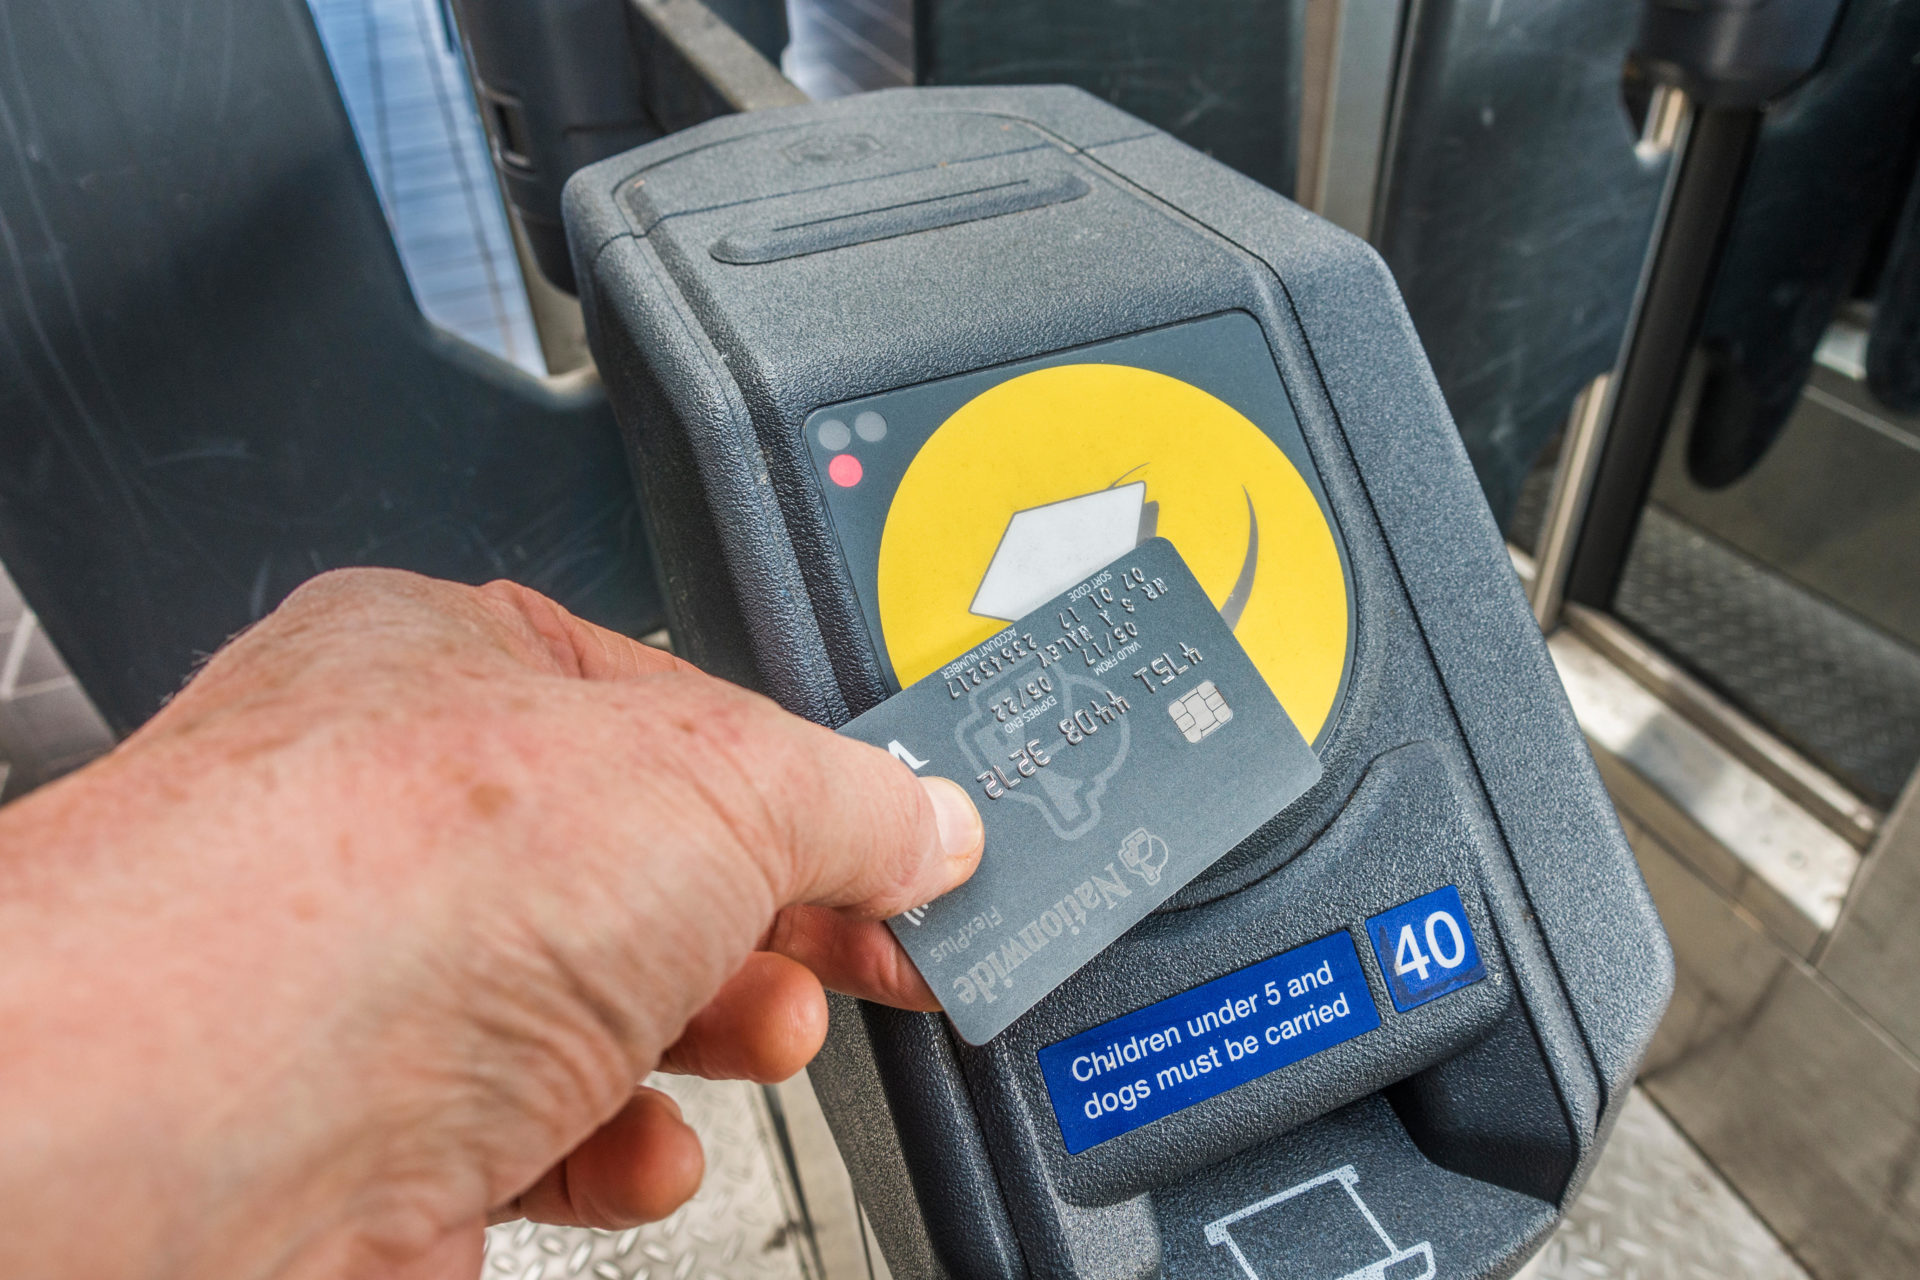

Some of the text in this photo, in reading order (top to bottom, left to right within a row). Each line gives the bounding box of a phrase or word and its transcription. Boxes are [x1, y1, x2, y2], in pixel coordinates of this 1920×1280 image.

[1067, 569, 1113, 603] SORT CODE
[1088, 587, 1114, 609] 01
[1120, 566, 1146, 591] 07
[1141, 576, 1168, 601] MR
[1097, 609, 1115, 628] A
[1120, 596, 1136, 614] S
[941, 626, 1019, 681] ACCOUNT NUMBER
[1081, 620, 1139, 667] 05/17
[1092, 640, 1142, 676] VALID FROM
[1133, 641, 1203, 694] 4751
[991, 675, 1053, 723] 05/22
[1003, 695, 1057, 734] EXPIRES END
[1058, 690, 1130, 746] 4408
[975, 738, 1051, 800] 3272
[929, 905, 1004, 964] FlexPlus
[952, 862, 1132, 1005] Nationwide
[1394, 911, 1465, 980] 40
[1072, 960, 1334, 1082] Children under 5 and
[1084, 992, 1350, 1119] dogs must be carried
